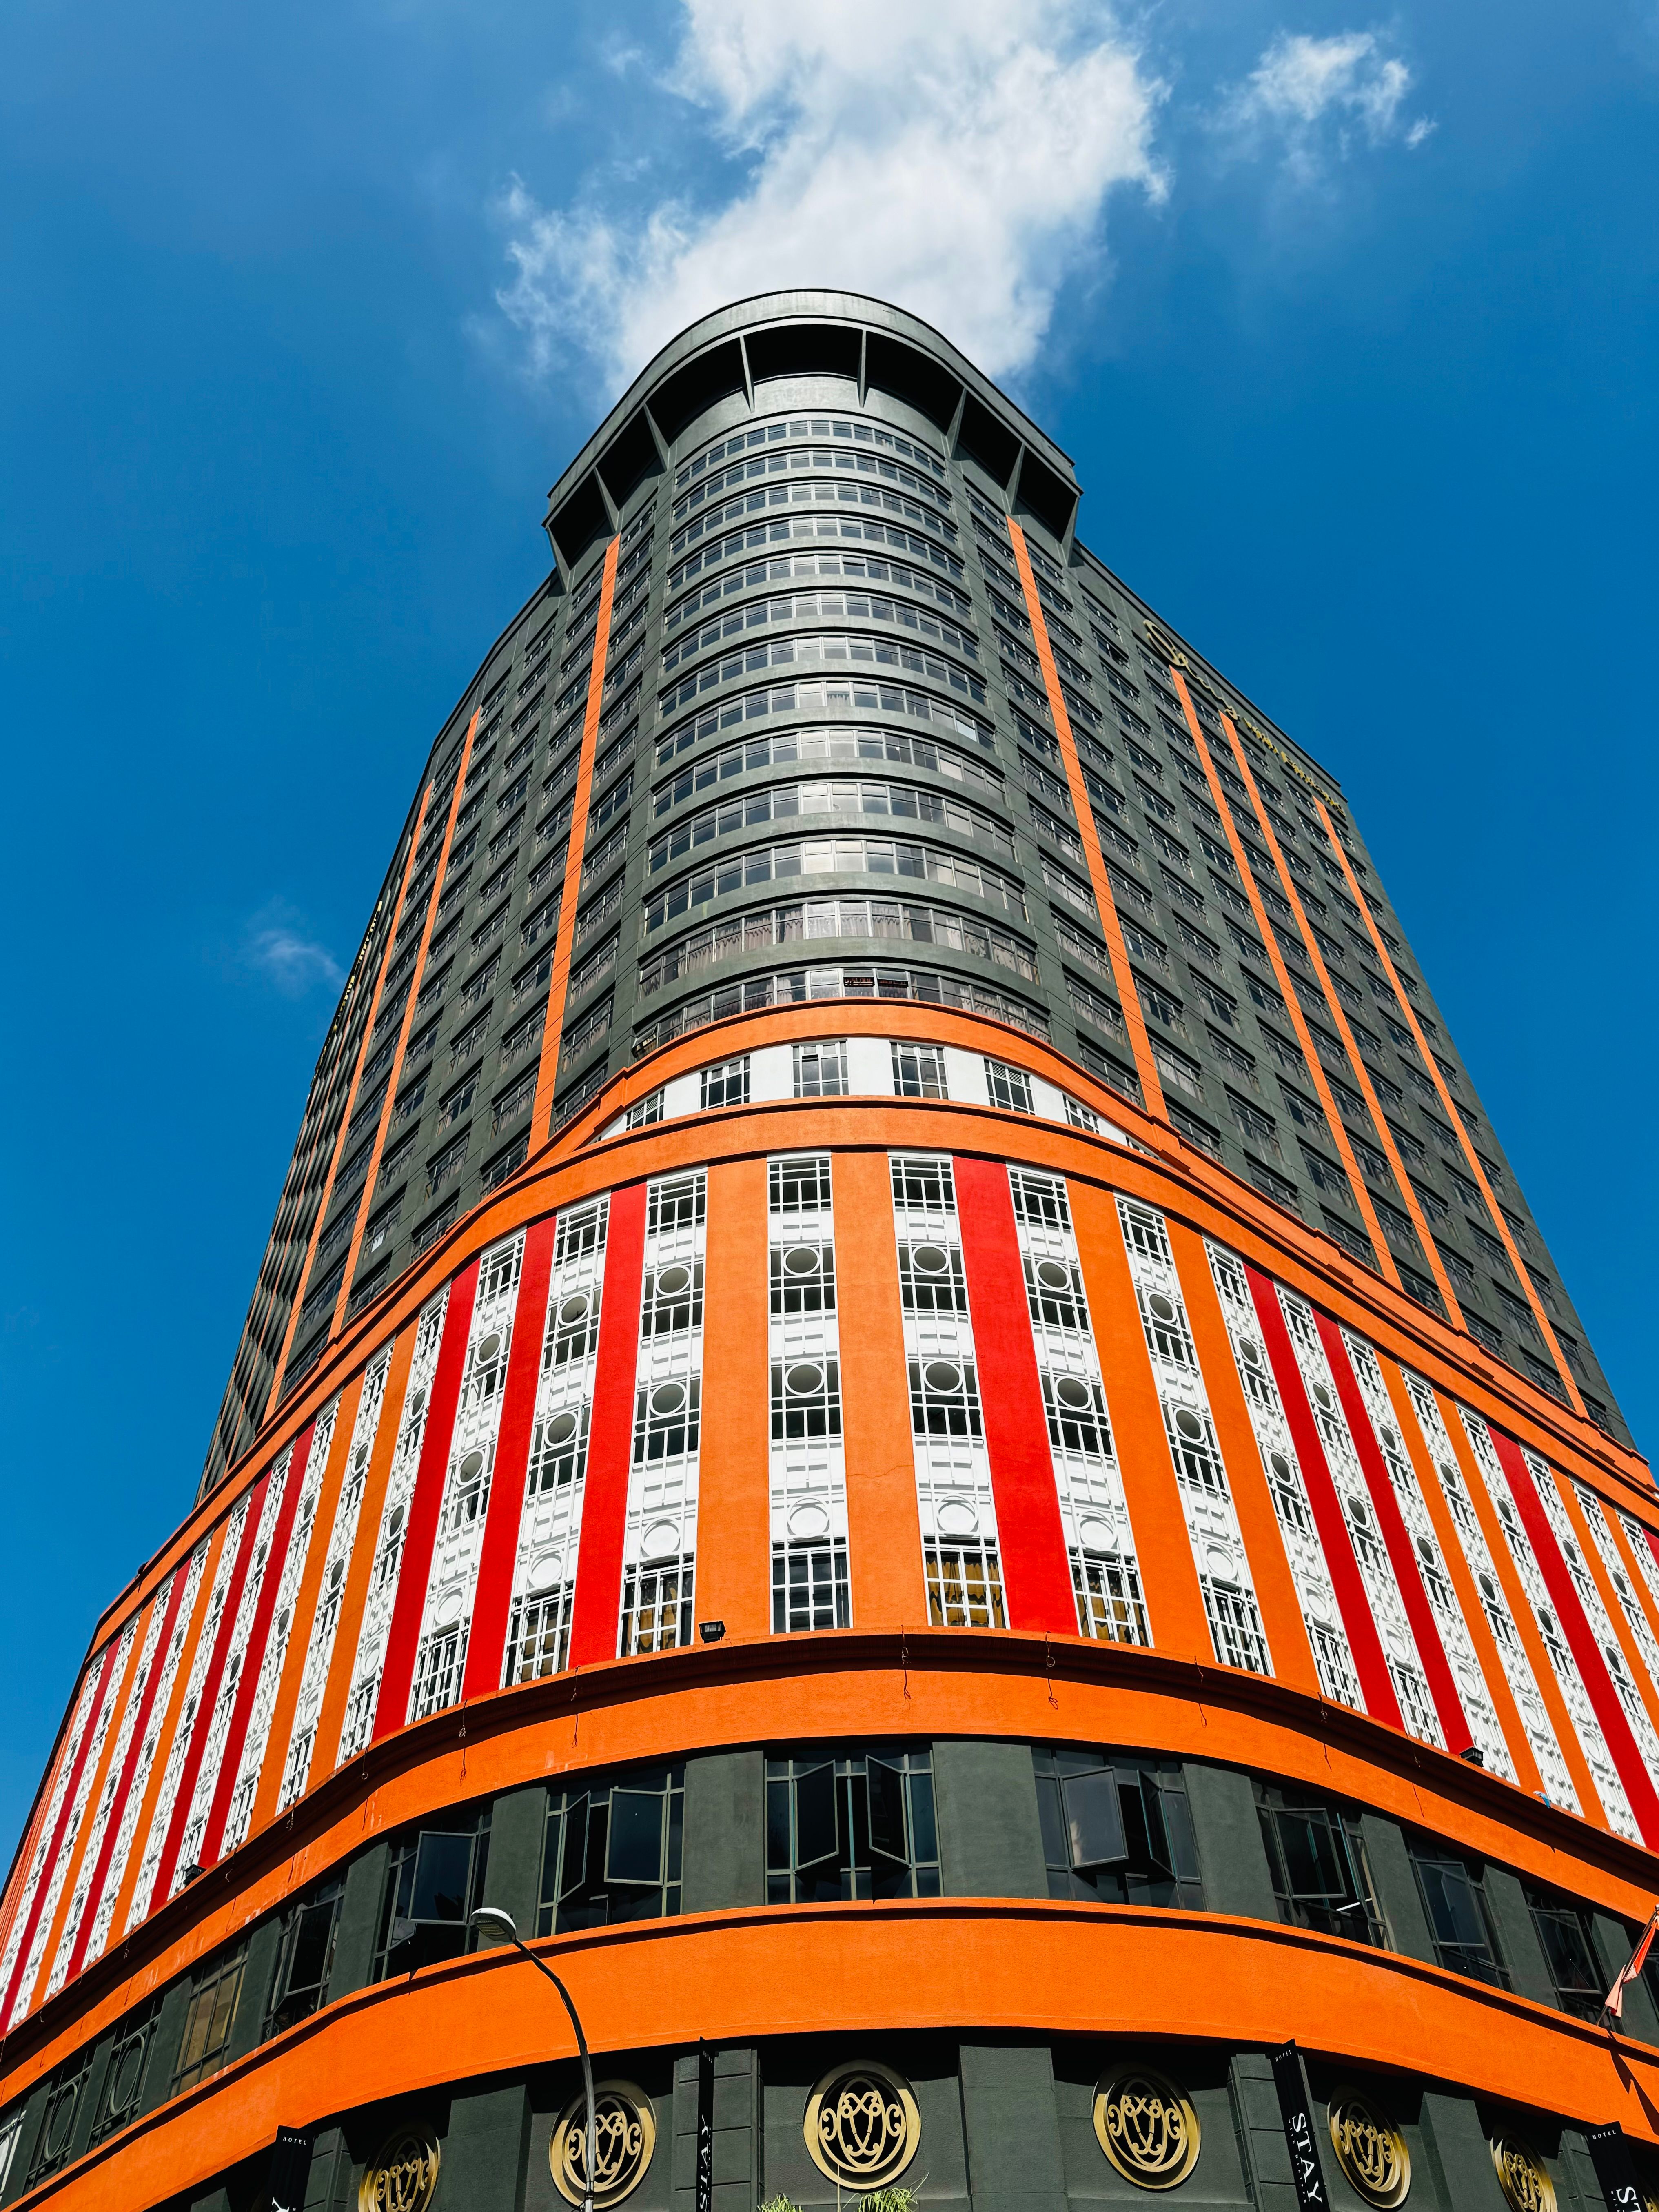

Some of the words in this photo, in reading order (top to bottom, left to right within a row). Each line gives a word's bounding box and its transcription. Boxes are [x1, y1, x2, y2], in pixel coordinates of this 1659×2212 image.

[1143, 619, 1240, 720] Stay
[1275, 2050, 1291, 2062] HOTEL
[283, 2136, 307, 2145] HOTEL
[1292, 2113, 1322, 2203] STAY
[1592, 2130, 1616, 2140] HOTEL
[700, 2114, 709, 2212] STAY
